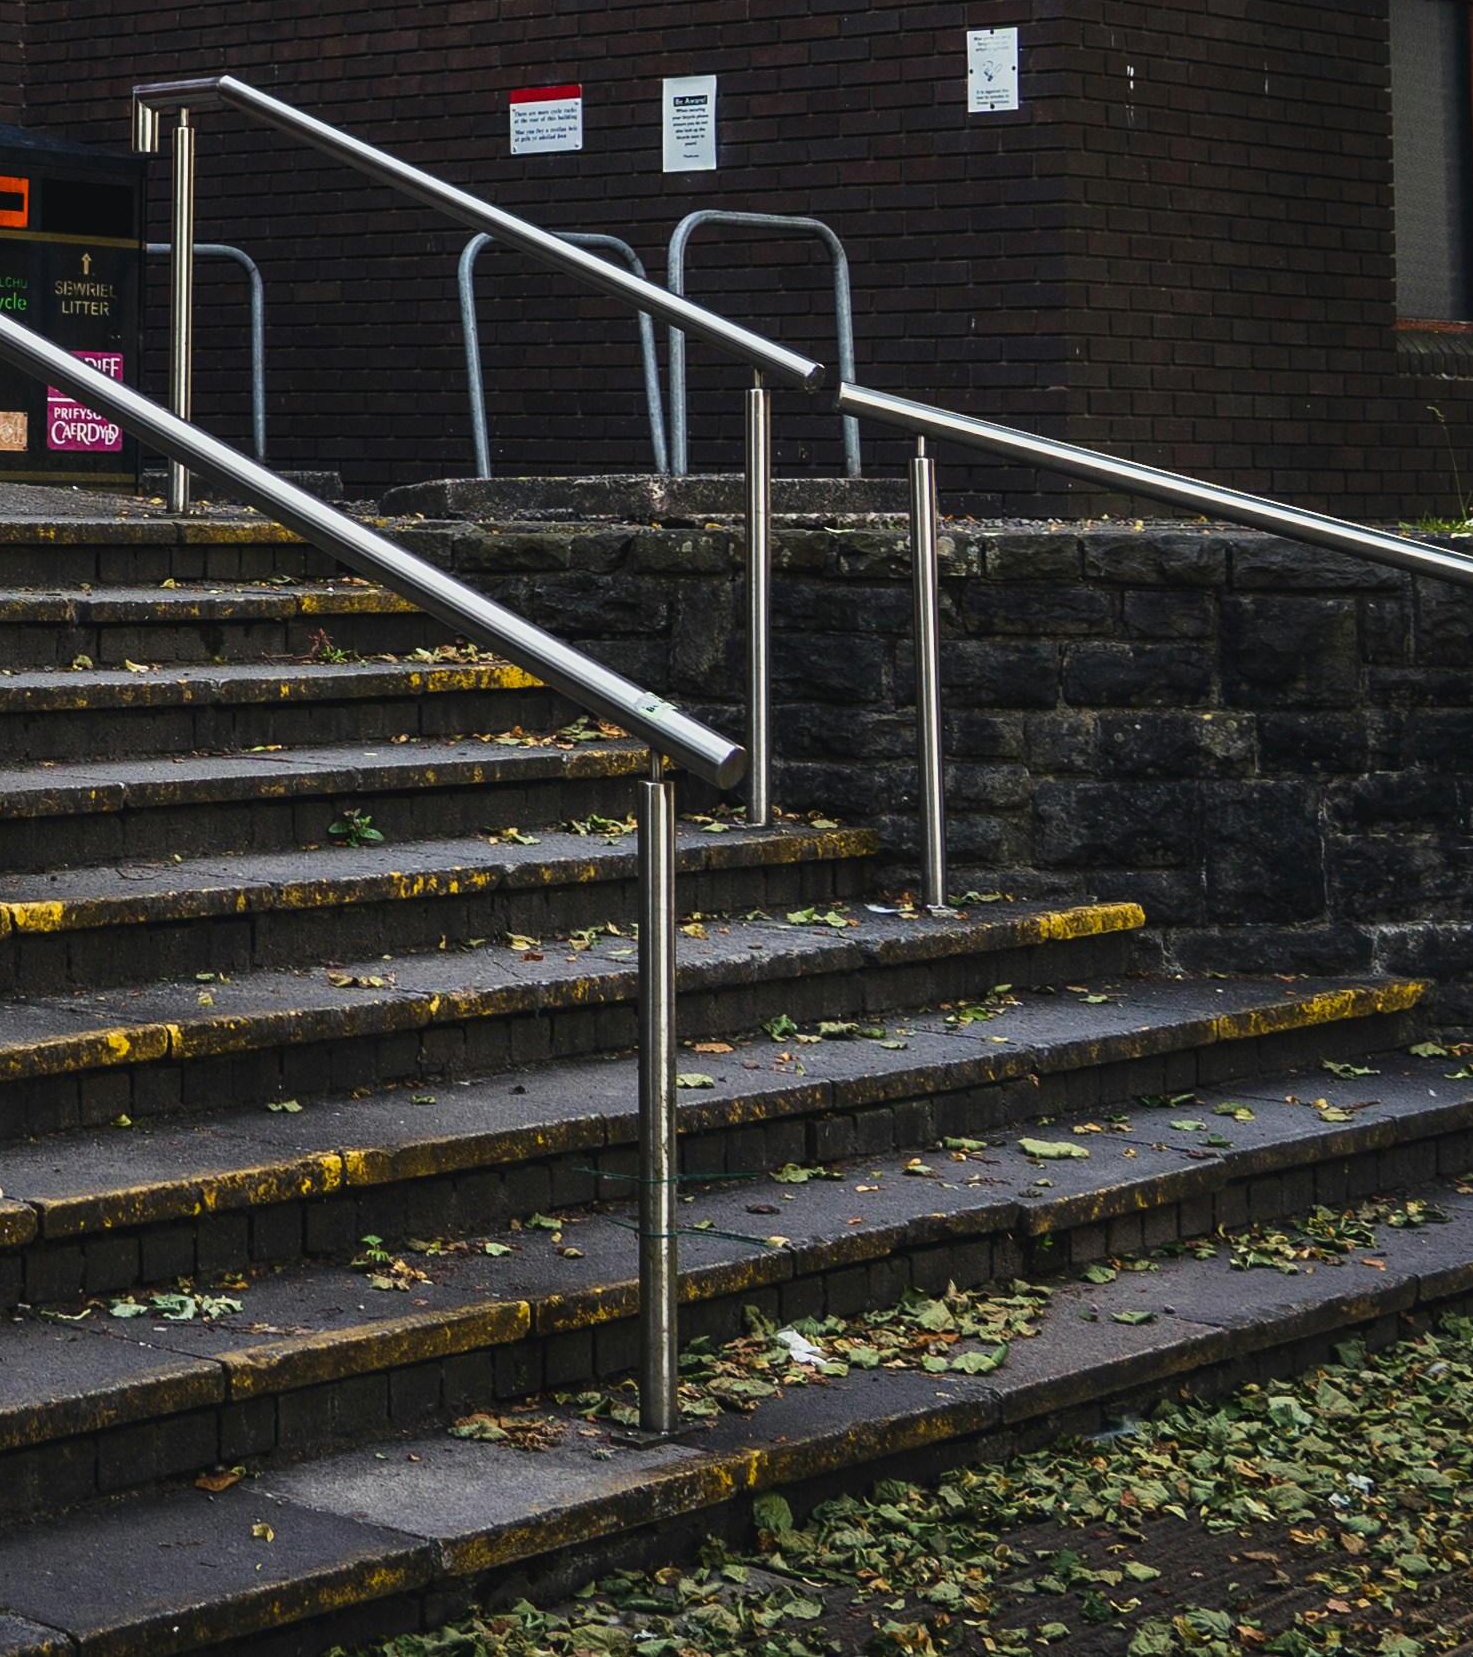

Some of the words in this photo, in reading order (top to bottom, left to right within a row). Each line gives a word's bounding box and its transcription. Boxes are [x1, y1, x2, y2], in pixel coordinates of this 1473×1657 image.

[54, 280, 117, 299] SBWRIEL
[61, 301, 111, 317] LITTER
[51, 420, 120, 446] CAERDYDD
